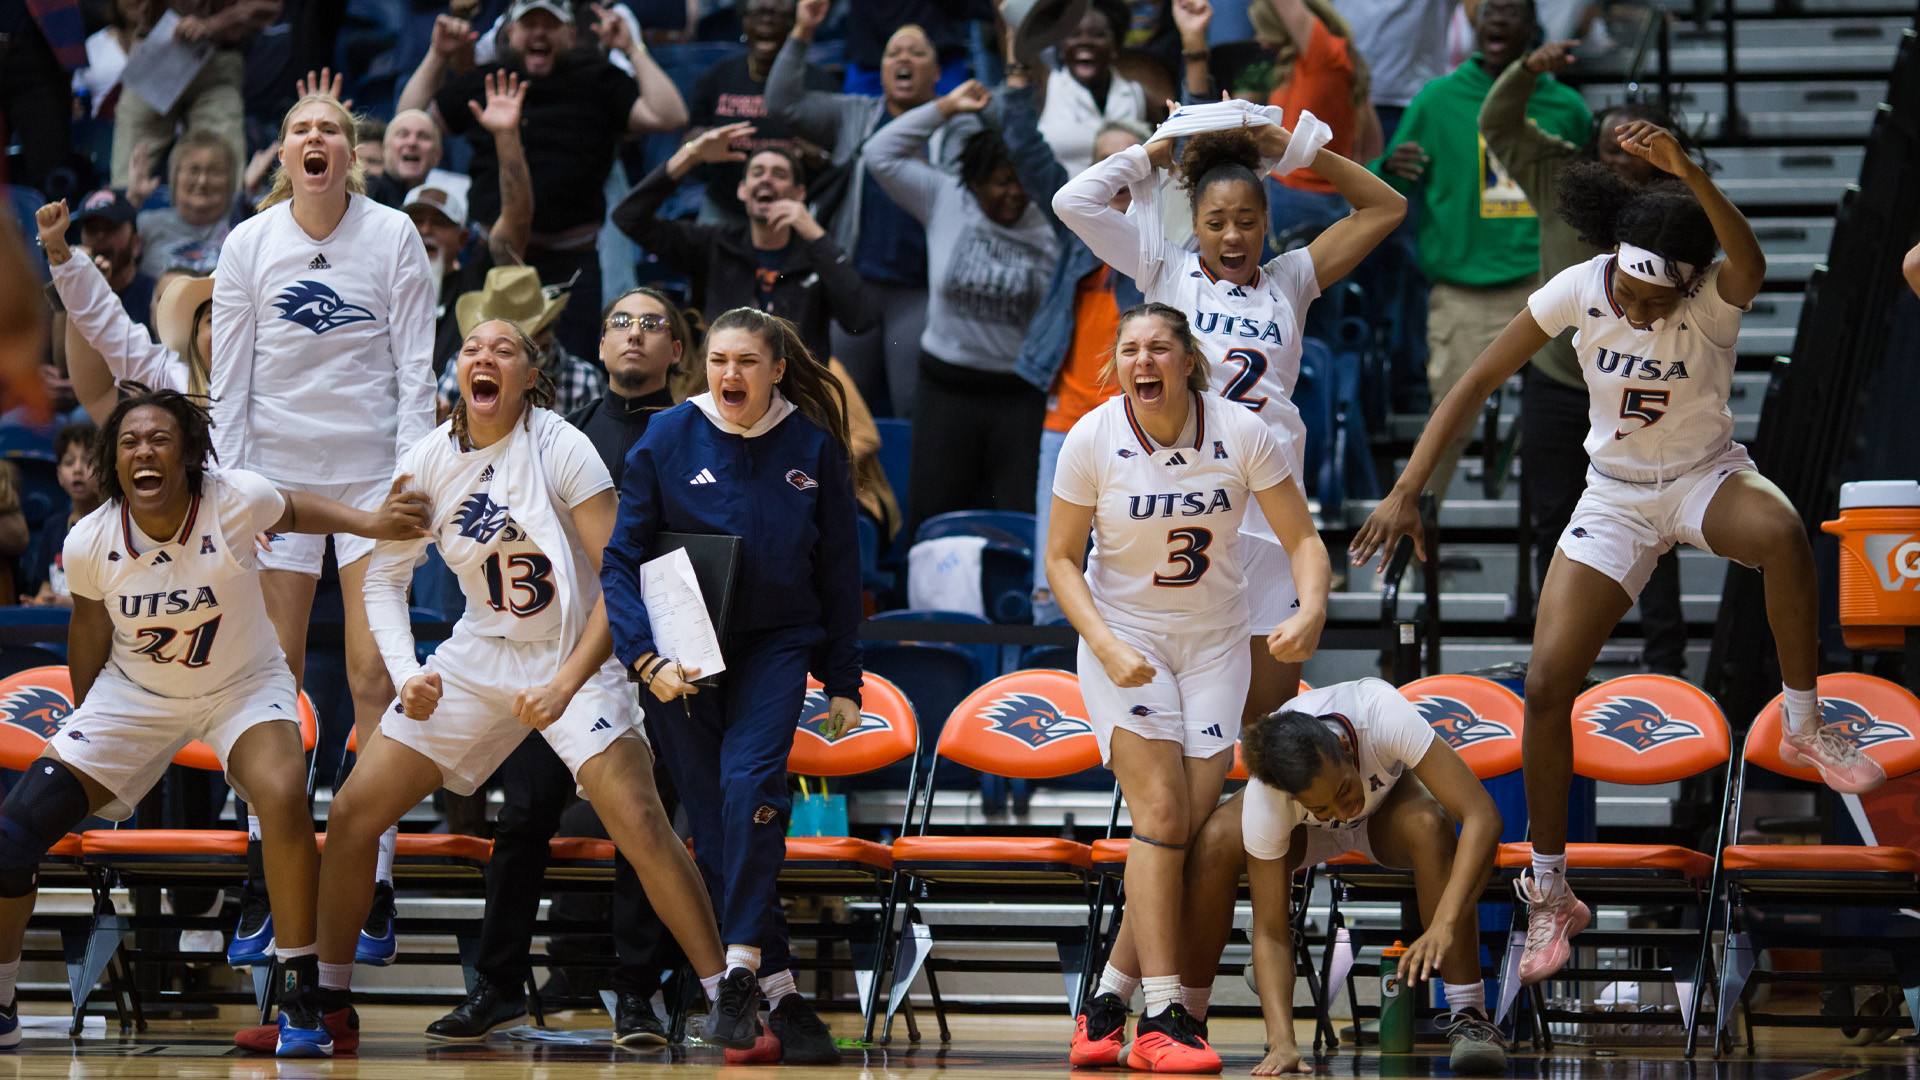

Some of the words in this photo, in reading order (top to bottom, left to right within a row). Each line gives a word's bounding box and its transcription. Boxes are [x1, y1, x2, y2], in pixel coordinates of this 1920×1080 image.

[1194, 309, 1283, 346] UTSA
[1219, 348, 1269, 413] 2
[1596, 346, 1690, 381] UTSA
[1615, 387, 1671, 441] 5
[1128, 488, 1232, 520] UTSA
[1153, 526, 1214, 588] 3
[118, 585, 219, 618] UTSA
[480, 551, 556, 619] 13
[130, 613, 223, 669] 21
